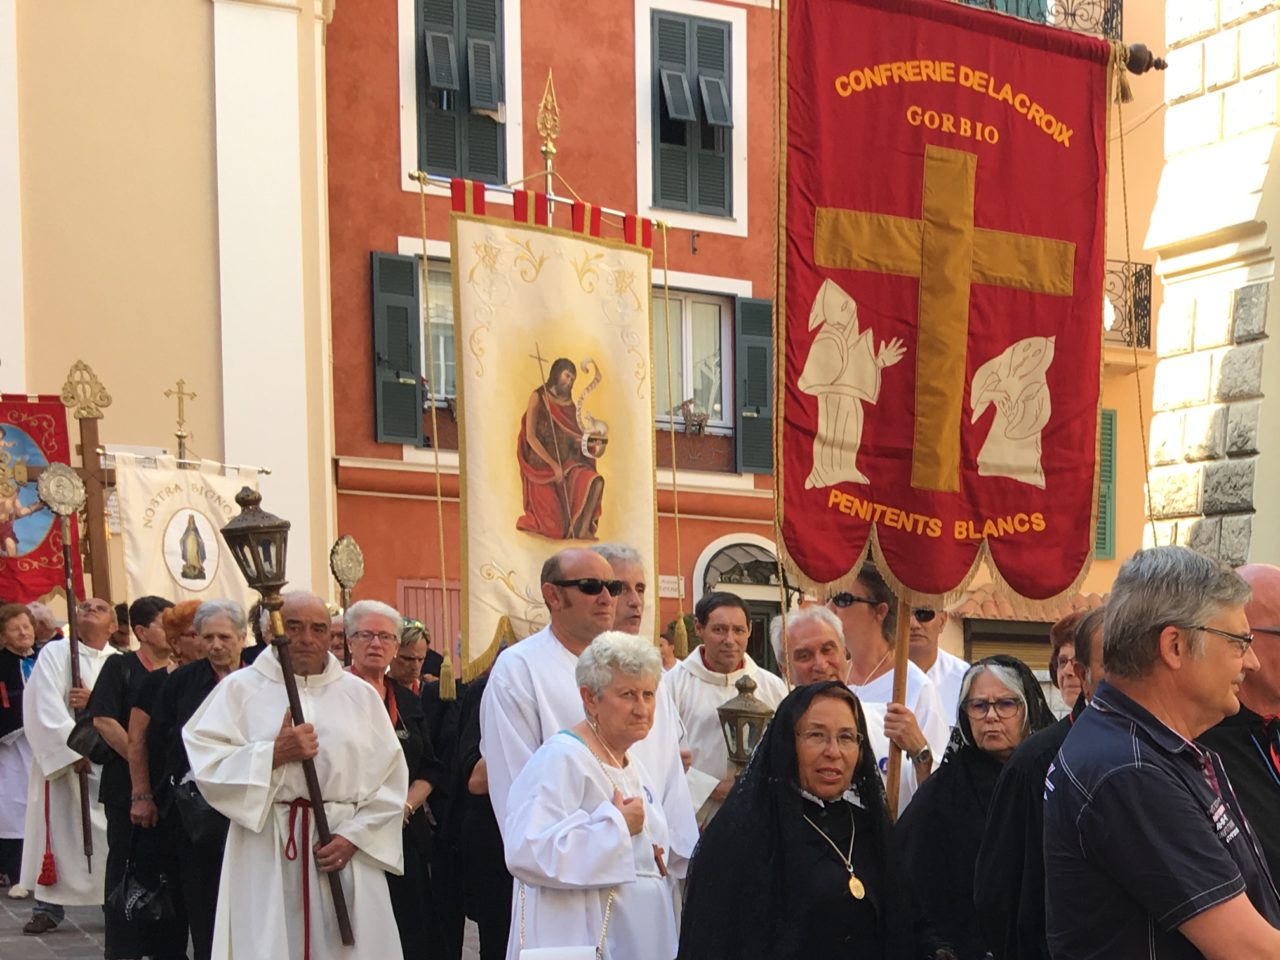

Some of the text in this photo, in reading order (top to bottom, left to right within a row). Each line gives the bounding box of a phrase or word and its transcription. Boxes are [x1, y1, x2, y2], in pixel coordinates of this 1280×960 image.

[834, 60, 956, 97] CONFRERIE
[906, 105, 999, 145] GORBIO
[142, 483, 183, 529] NOSTRA
[191, 483, 236, 519] SIGNO
[828, 489, 1046, 540] PENITENTS BLANCS
